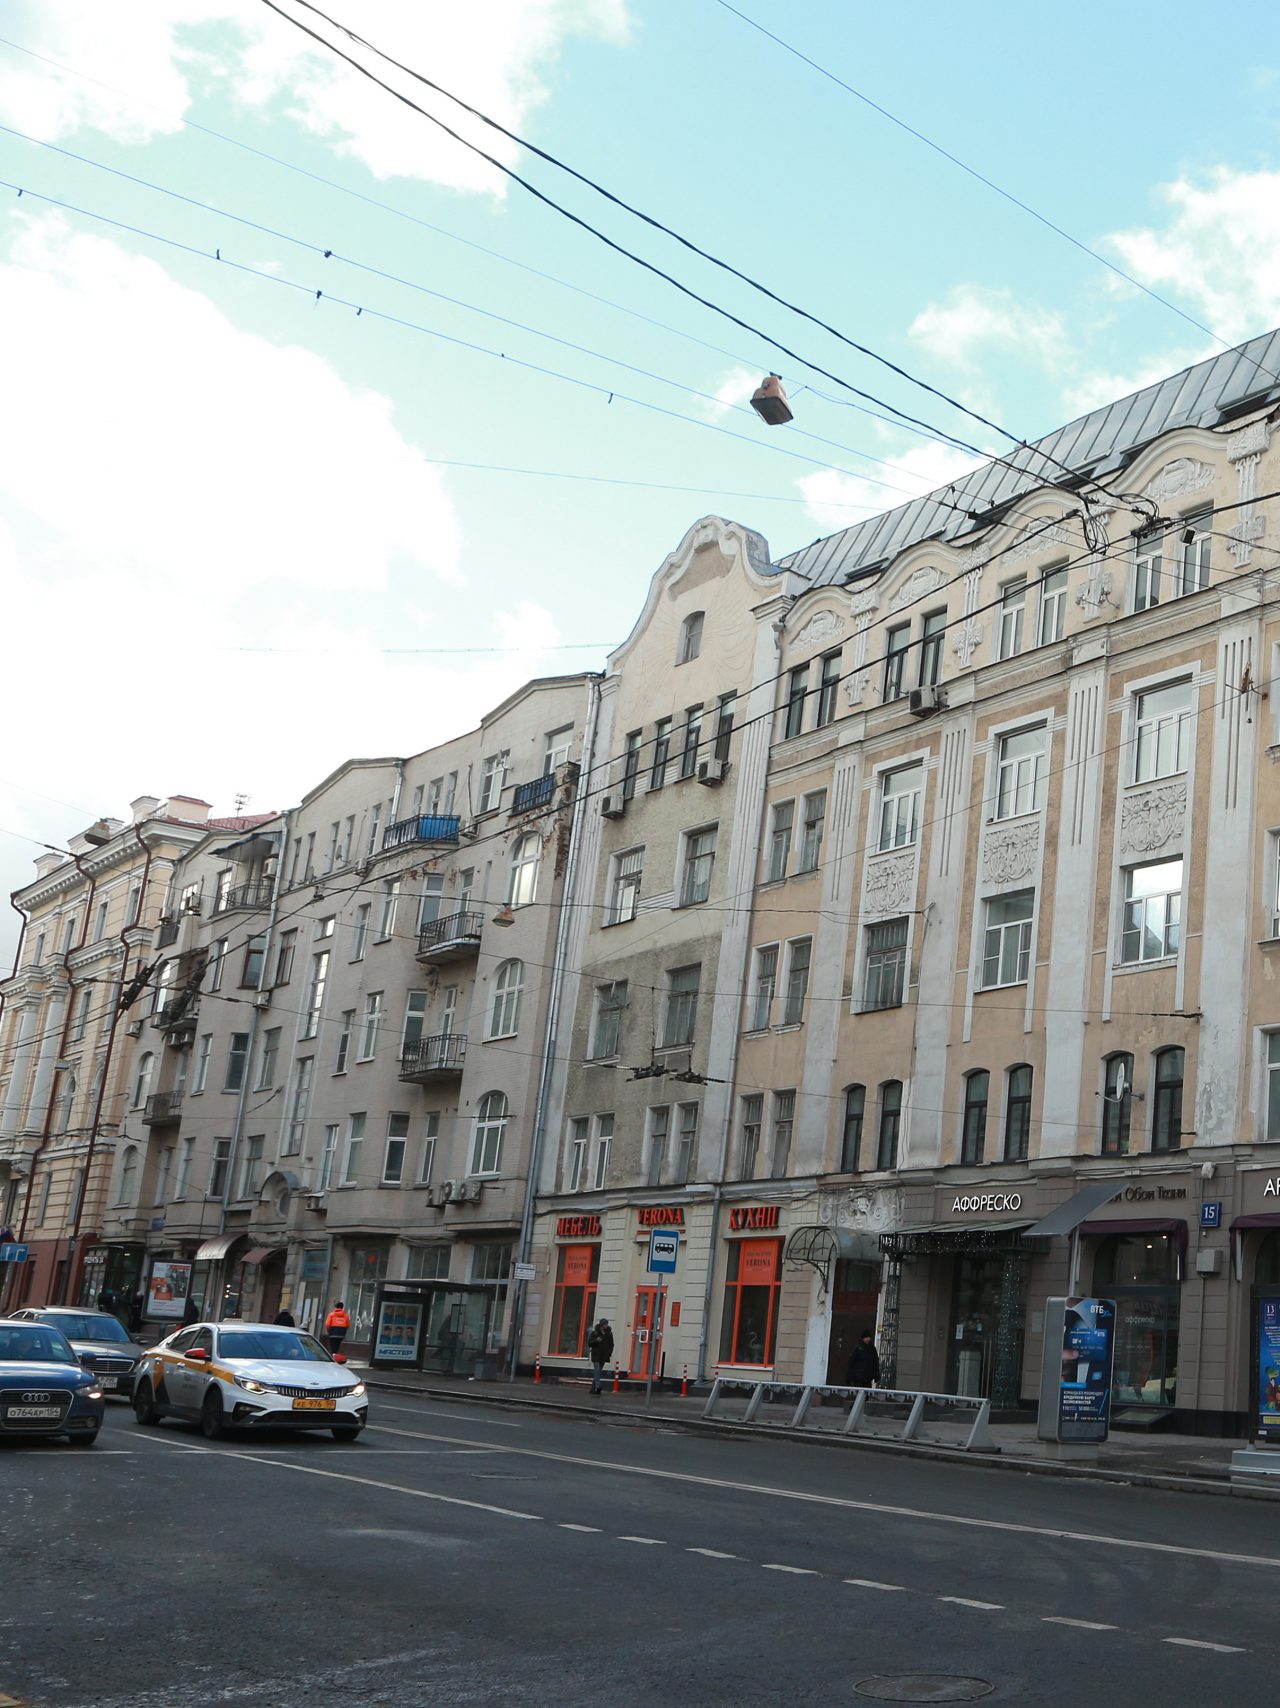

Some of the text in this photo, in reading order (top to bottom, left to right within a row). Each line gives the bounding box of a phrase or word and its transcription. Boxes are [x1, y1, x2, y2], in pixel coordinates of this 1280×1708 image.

[1125, 1186, 1155, 1202] Обои
[1157, 1185, 1186, 1200] Ткани
[951, 1193, 1022, 1212] АФФРЕСКО
[637, 1207, 685, 1225] VERONA
[1204, 1206, 1215, 1219] 15
[556, 1215, 602, 1237] МЕБЕЛЬ
[1090, 1304, 1104, 1314] ВТБ
[1267, 1305, 1275, 1314] 13
[310, 1400, 322, 1408] 976
